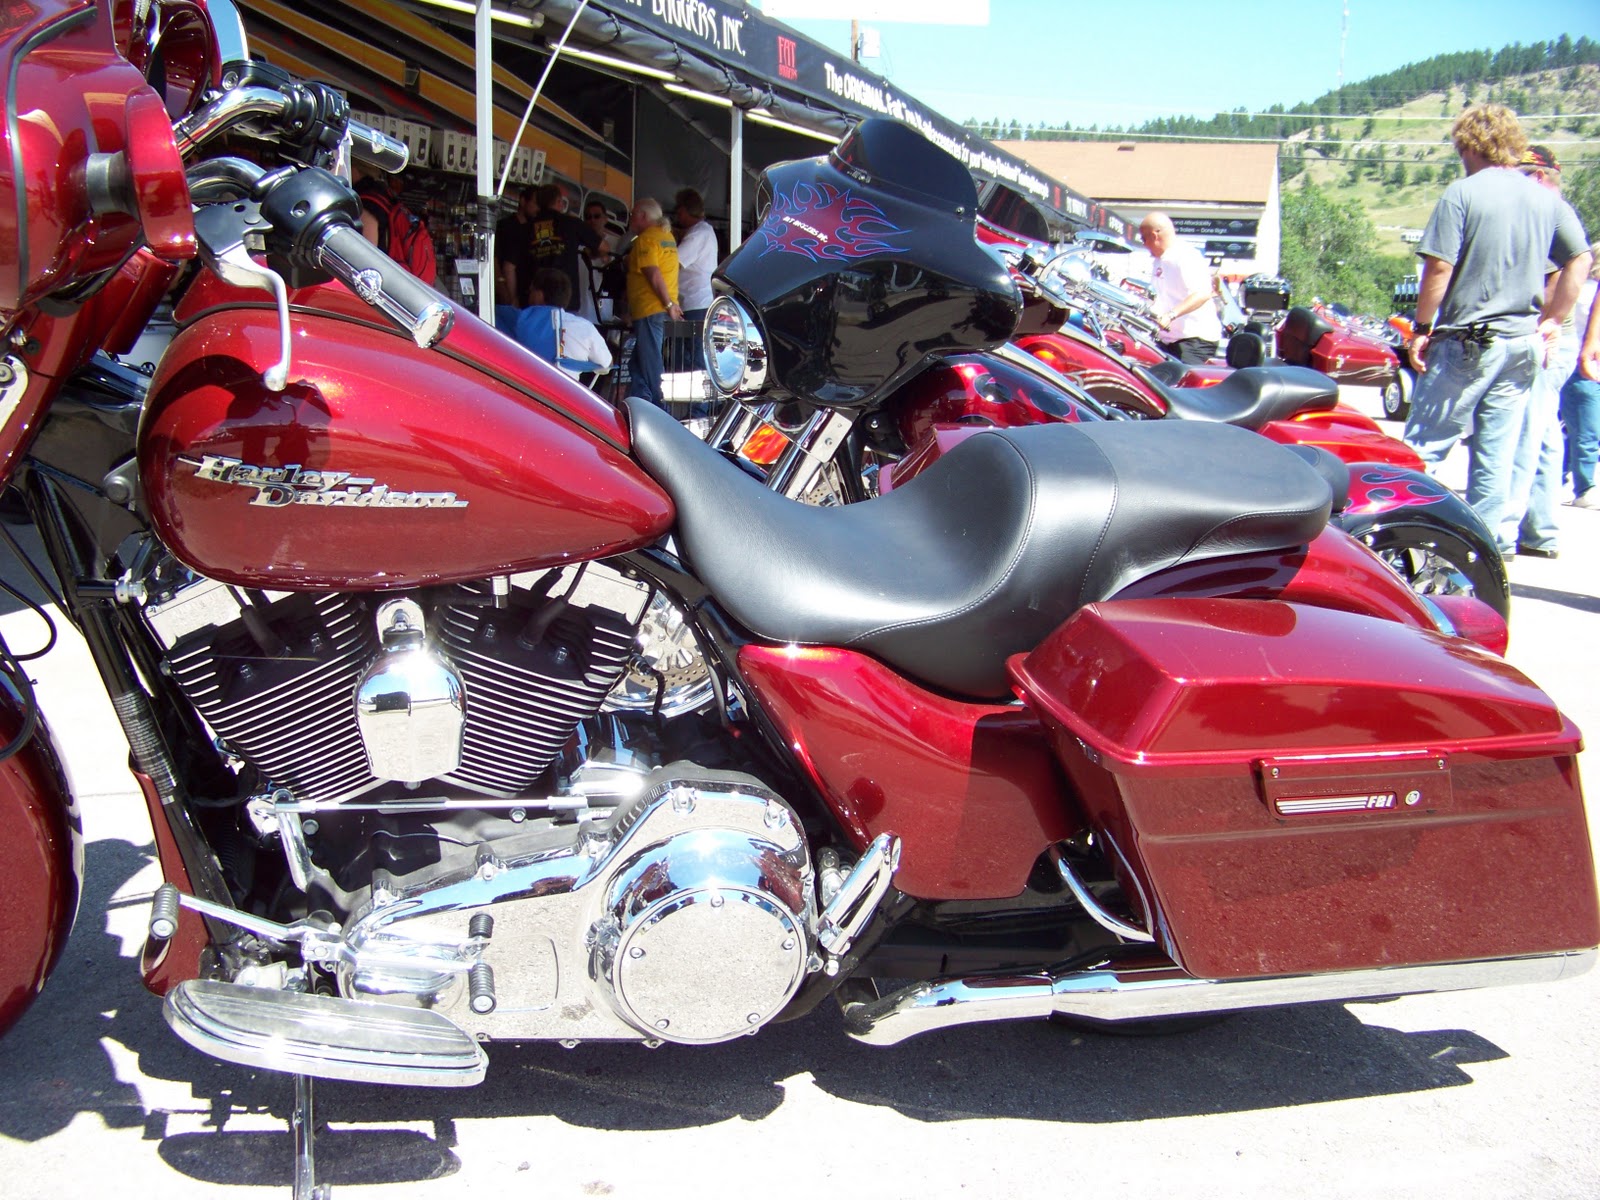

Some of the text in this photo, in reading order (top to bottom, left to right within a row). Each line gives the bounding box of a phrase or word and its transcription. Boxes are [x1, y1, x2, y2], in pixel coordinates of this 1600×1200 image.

[778, 36, 796, 68] FAT
[824, 62, 843, 96] The
[249, 483, 469, 508] Davidson
[1366, 794, 1394, 809] FBI
